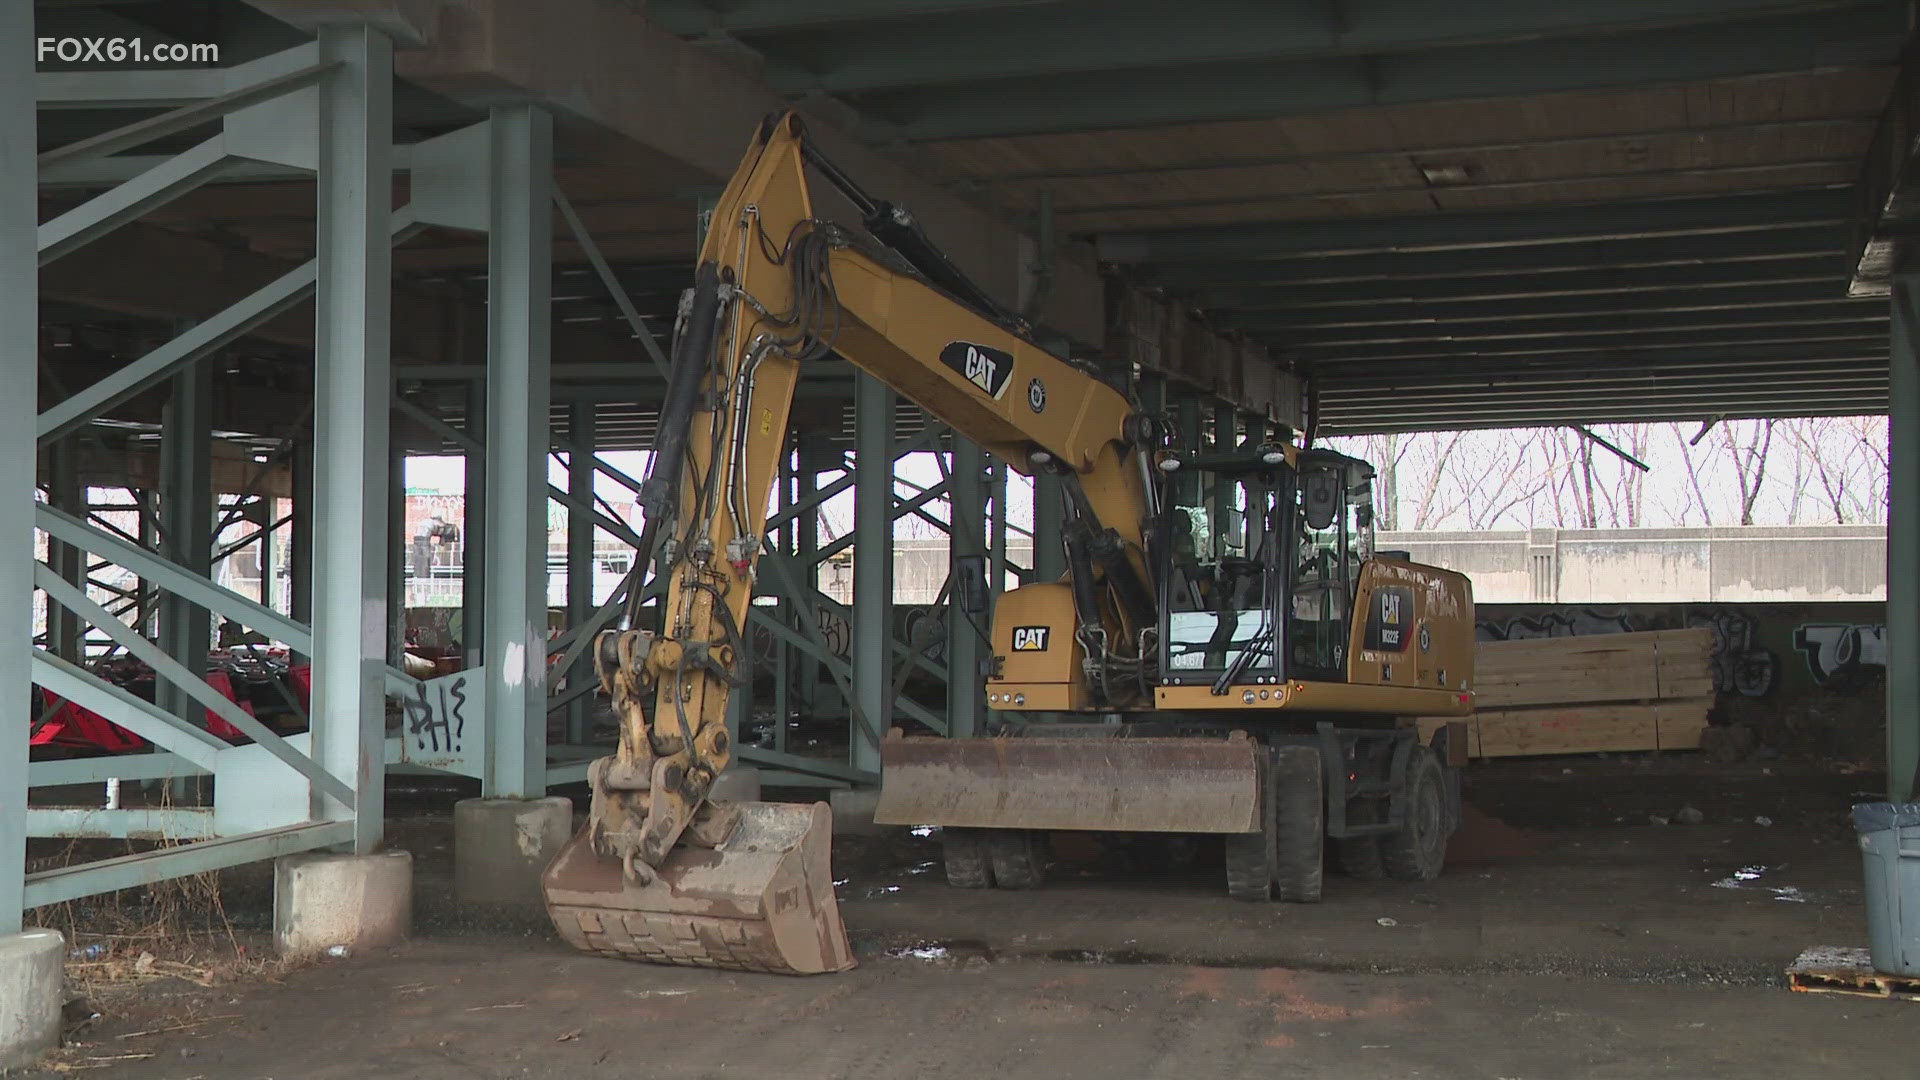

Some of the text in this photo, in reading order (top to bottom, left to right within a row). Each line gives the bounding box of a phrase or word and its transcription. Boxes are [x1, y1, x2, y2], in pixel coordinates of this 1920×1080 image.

[965, 346, 996, 393] CAT
[1381, 593, 1400, 624] CAT
[1015, 629, 1045, 650] CAT
[1382, 629, 1399, 645] M322F
